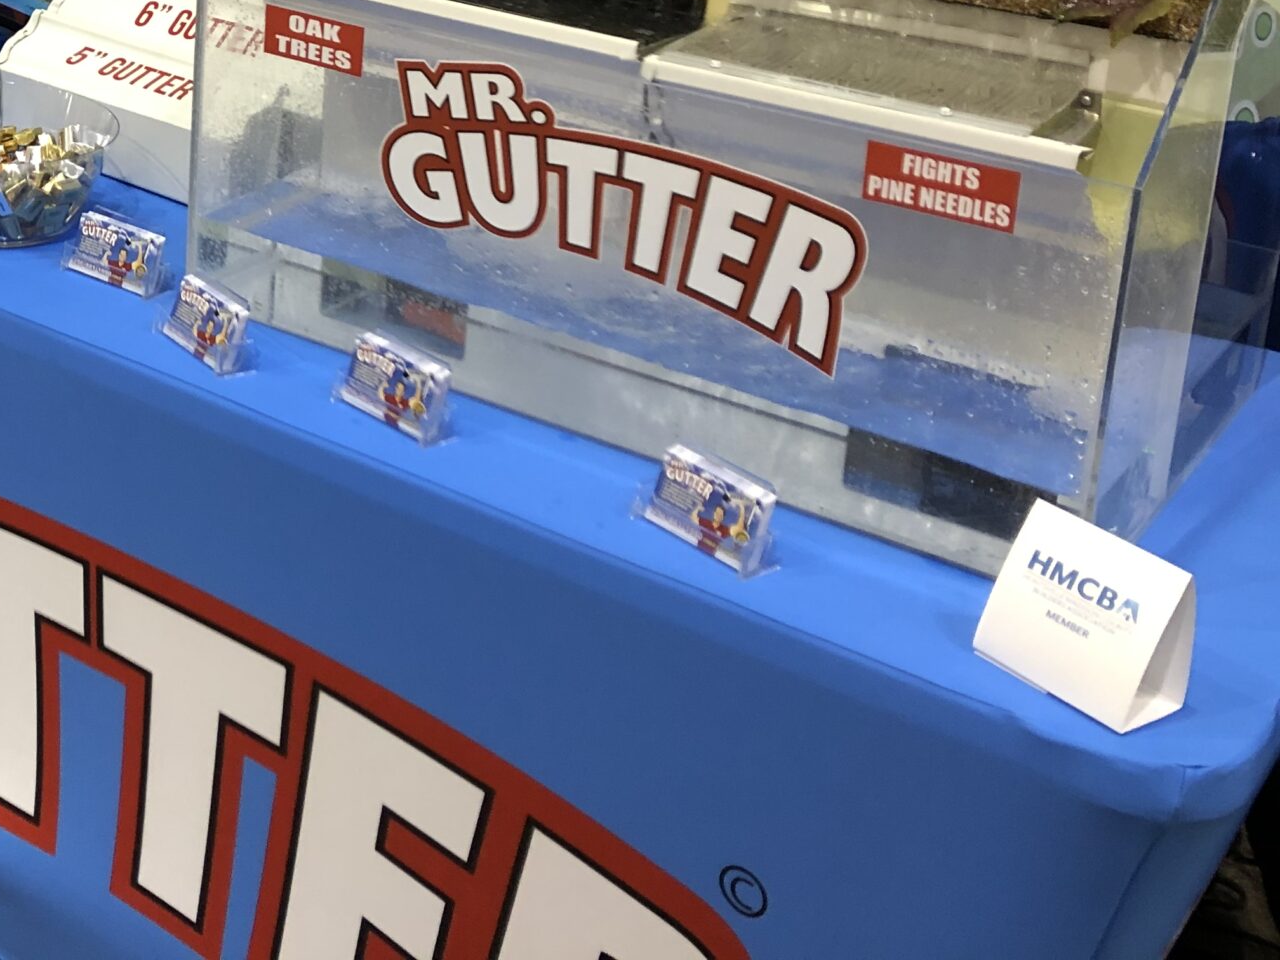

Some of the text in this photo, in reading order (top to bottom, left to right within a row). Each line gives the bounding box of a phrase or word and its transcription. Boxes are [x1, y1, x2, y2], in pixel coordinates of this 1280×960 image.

[288, 14, 341, 43] OAK
[275, 34, 352, 70] TREES
[98, 57, 194, 100] GUTTER
[405, 70, 548, 126] MR.
[902, 153, 981, 190] FIGHTS
[868, 175, 1010, 227] PINE NEEDLES
[82, 224, 118, 246] GUTTER
[387, 131, 857, 361] GUTTER
[180, 290, 210, 315] GUTTER
[666, 468, 714, 500] GUTTER
[1027, 549, 1140, 625] HMCBA
[1045, 610, 1090, 639] MEMBER
